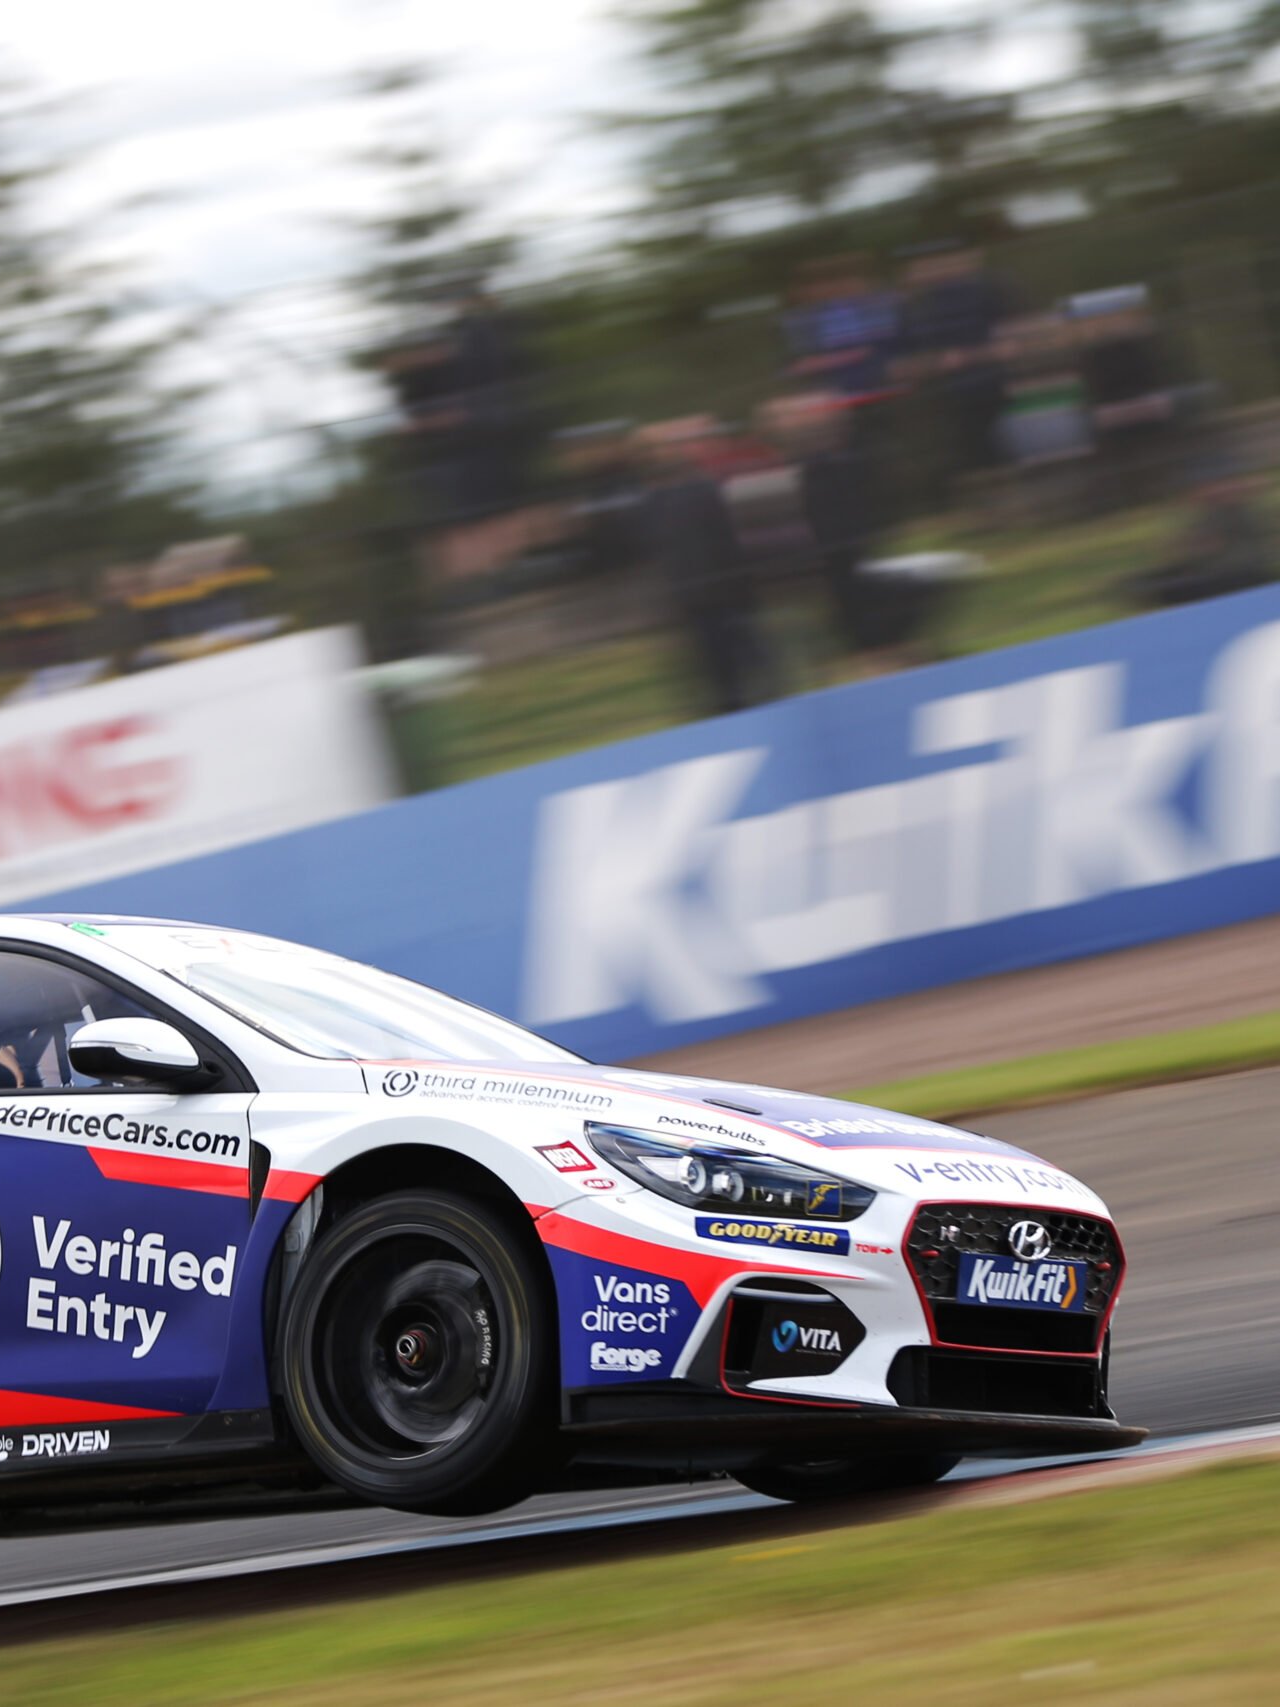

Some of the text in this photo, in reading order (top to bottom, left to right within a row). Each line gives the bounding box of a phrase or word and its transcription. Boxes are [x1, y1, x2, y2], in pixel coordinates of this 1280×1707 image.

[423, 1073, 477, 1090] third
[483, 1079, 613, 1108] millennium
[657, 1115, 766, 1147] powerbulbs
[709, 1221, 838, 1247] GOODYEAR
[32, 1215, 237, 1298] Verified
[593, 1274, 671, 1304] Vans
[26, 1277, 167, 1359] Entry
[581, 1304, 670, 1334] direct
[799, 1326, 842, 1352] VITA
[21, 1429, 110, 1458] DRIVEN
